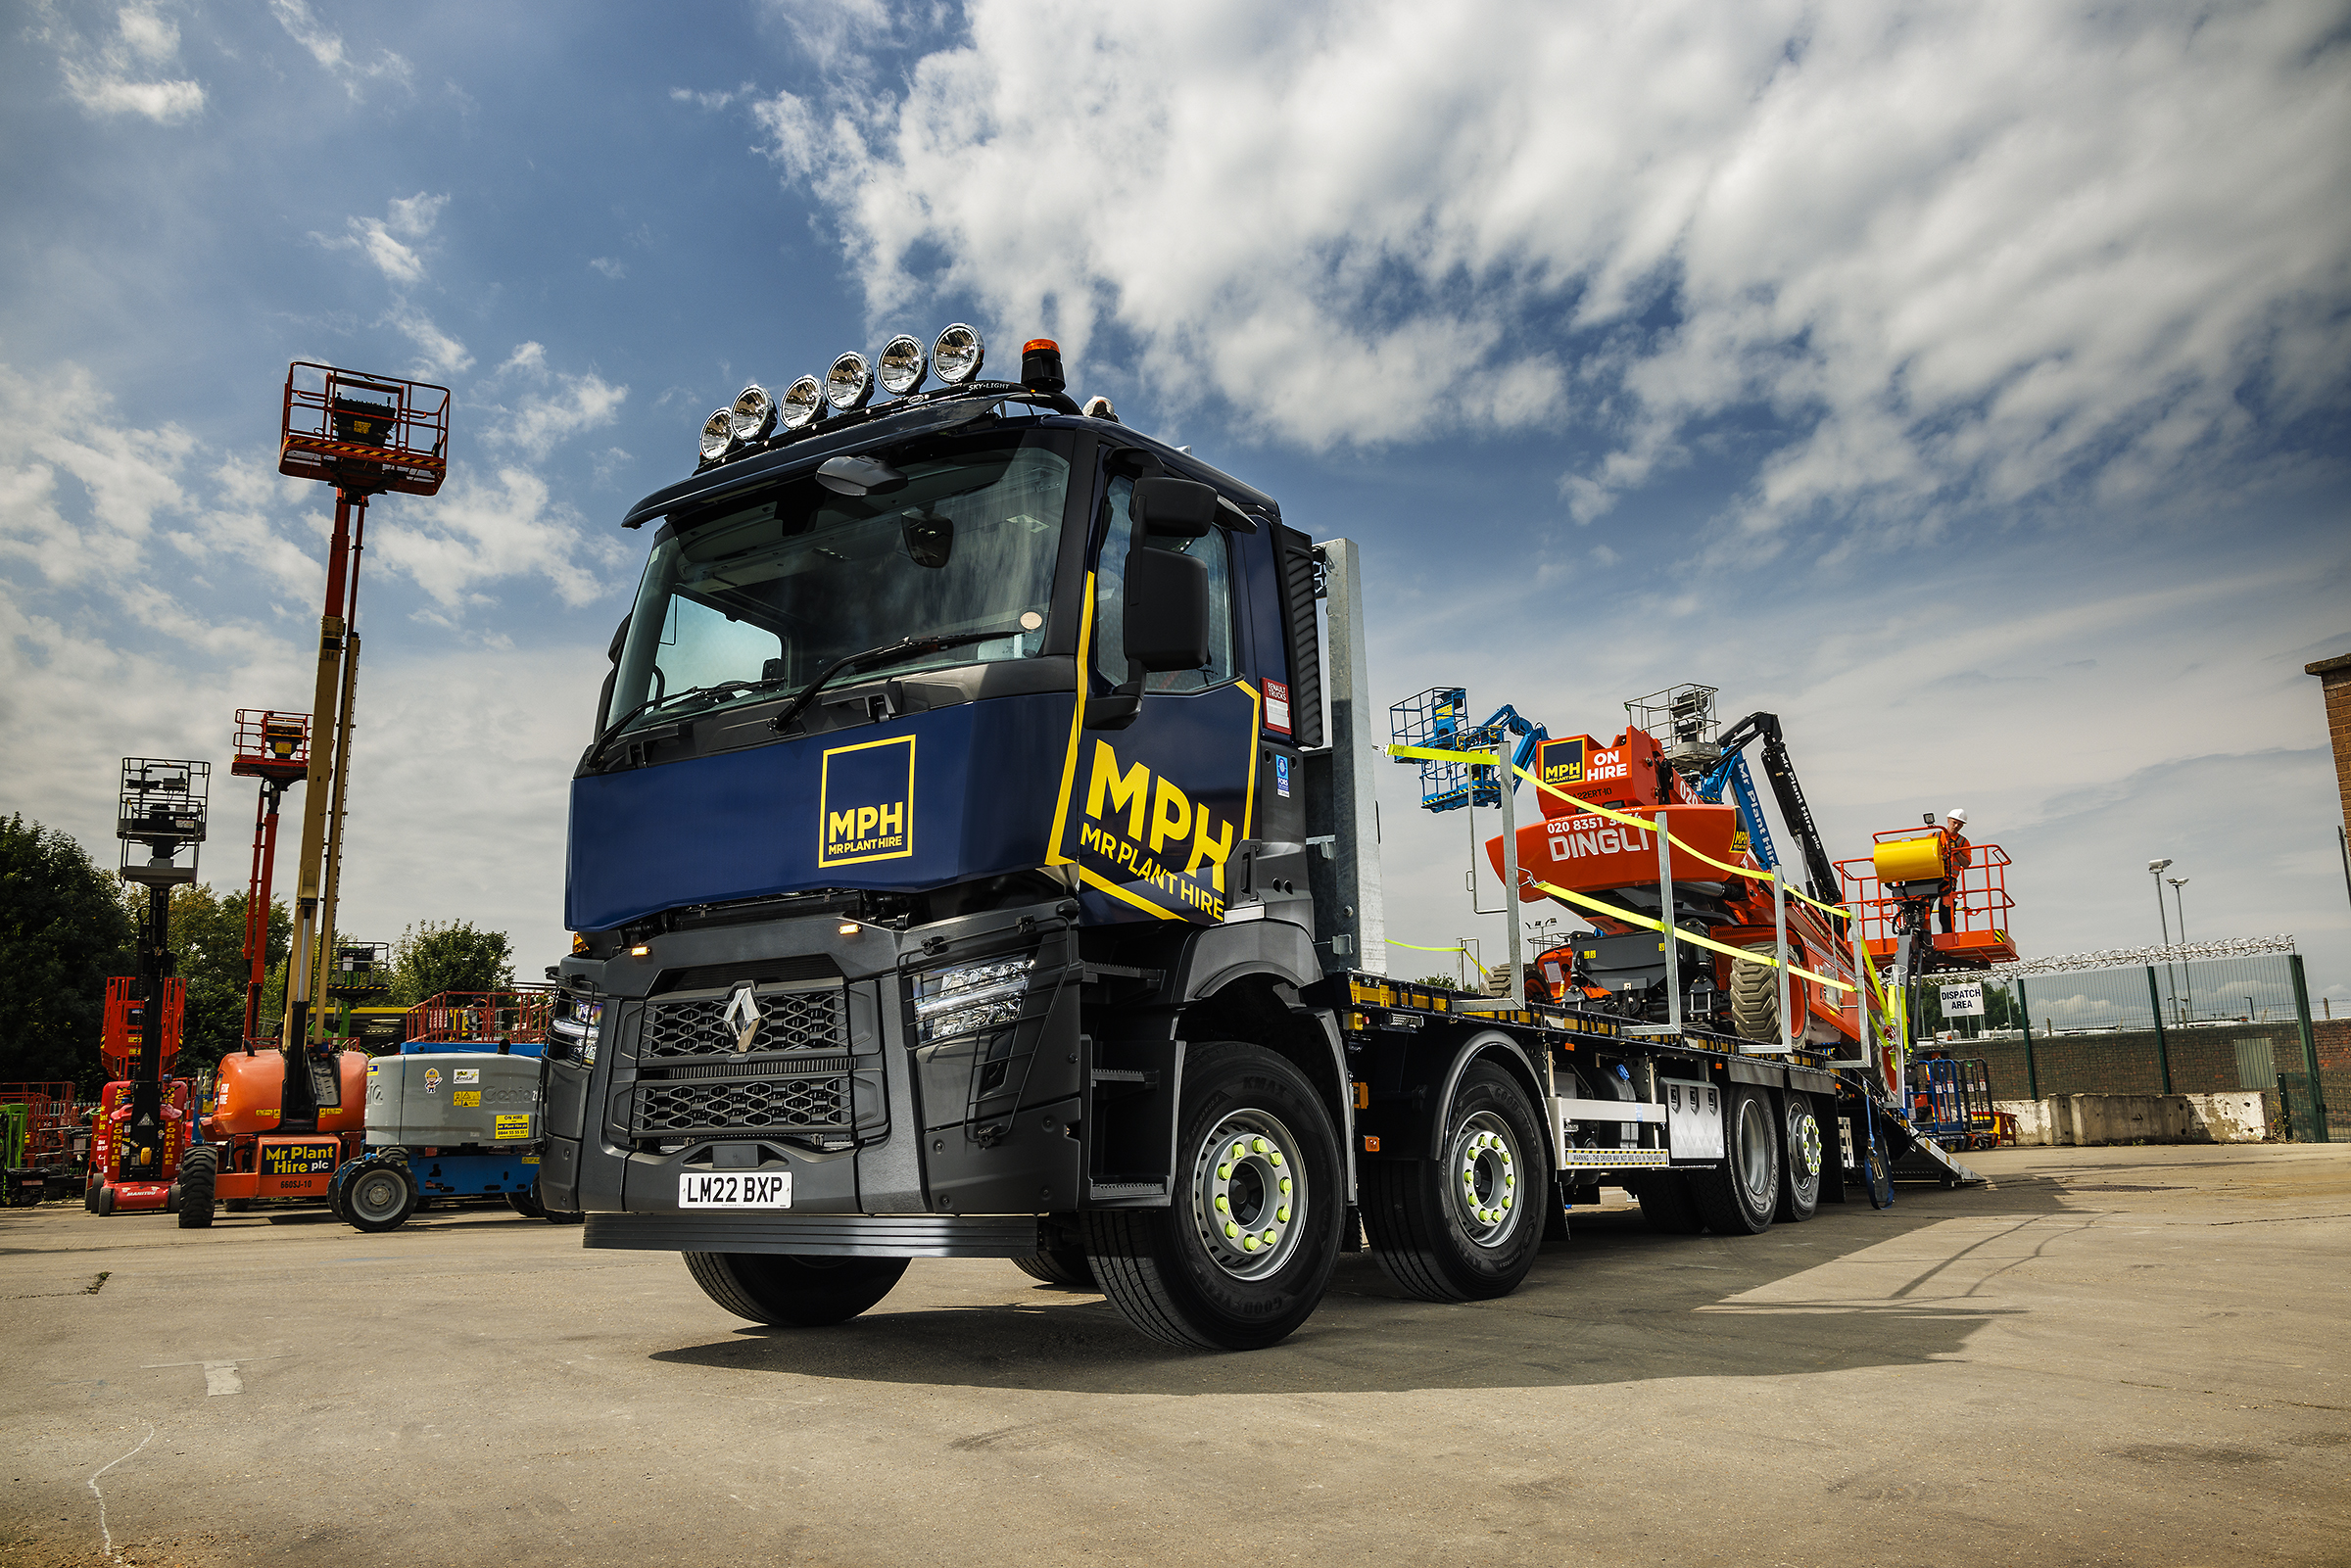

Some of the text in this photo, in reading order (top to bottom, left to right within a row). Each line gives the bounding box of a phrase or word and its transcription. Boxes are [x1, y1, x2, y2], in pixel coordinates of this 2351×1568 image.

[1267, 682, 1286, 693] RENAULT
[1269, 689, 1287, 701] TRUCKS
[1593, 750, 1619, 766] ON
[1545, 761, 1581, 780] MPH
[1587, 763, 1627, 782] HIRE
[1277, 777, 1288, 786] FORS
[1738, 762, 1750, 785] Mr
[1748, 790, 1766, 834] Plant
[1779, 751, 1821, 850] Mr Plant Hire plc
[829, 801, 903, 843] MPH
[1085, 738, 1233, 894] MPH
[1547, 822, 1569, 834] 020
[1572, 817, 1604, 831] 8351
[828, 835, 903, 855] MR PLANT HIRE
[1547, 828, 1650, 862] DINGLI
[1080, 822, 1224, 923] MR PLANT HIRE
[1942, 989, 1982, 1001] DISPATCH
[1951, 1000, 1973, 1010] AREA
[482, 1085, 531, 1104] Genie
[111, 1142, 121, 1166] HIRE
[165, 1141, 174, 1165] HIRE
[265, 1146, 333, 1161] Mr Plant
[273, 1160, 329, 1173] Hire plc
[280, 1180, 312, 1189] 660SJ-10
[687, 1176, 783, 1203] LM22 BXP
